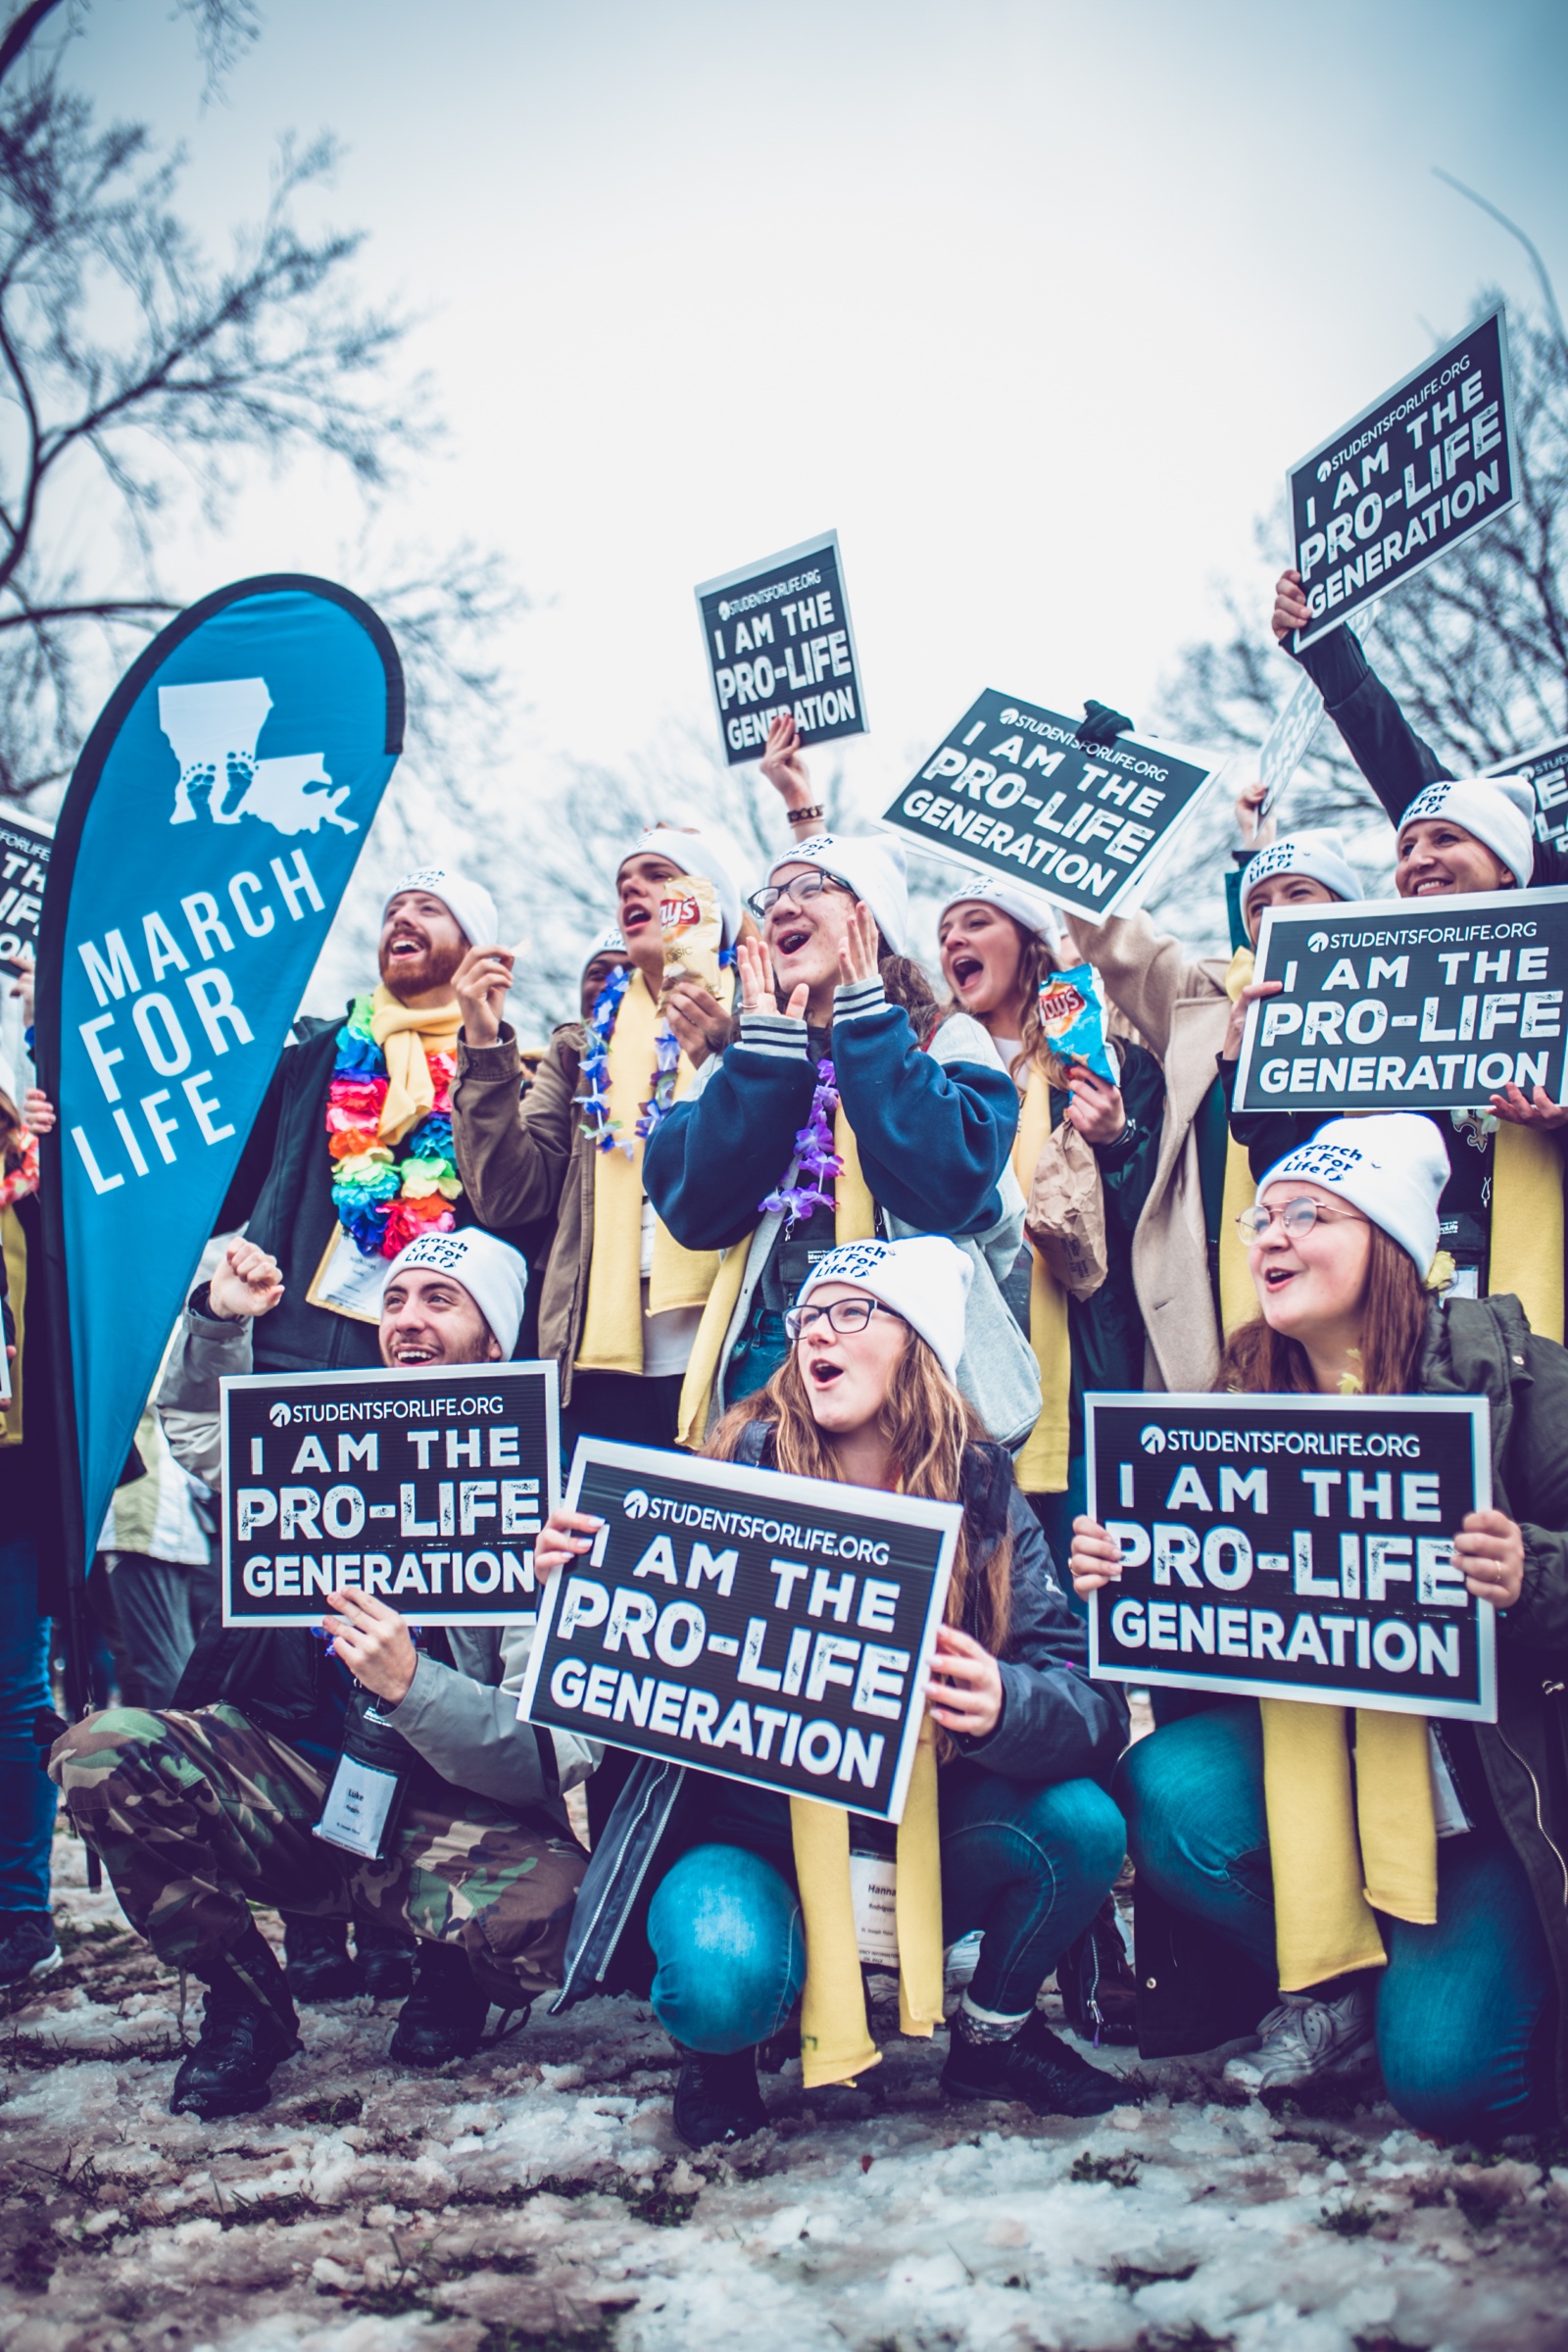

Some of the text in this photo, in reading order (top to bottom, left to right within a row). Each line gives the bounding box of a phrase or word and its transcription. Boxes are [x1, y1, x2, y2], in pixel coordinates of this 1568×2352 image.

[1331, 354, 1470, 470] STUDENTSFORLIFE.ORG
[1306, 369, 1484, 528] I AM THE
[1300, 400, 1502, 583] PRO-LIFE
[1306, 459, 1499, 619] GENERATION
[728, 569, 821, 615] STUDENTSFORLIFE.ORG
[714, 591, 835, 660] I AM THE
[715, 630, 852, 710] PRO-LIFE
[962, 720, 1166, 818] I AM THE
[1016, 714, 1168, 782] STUDENTSFORLIFE.ORG
[922, 747, 1155, 864] PRO-LIFE
[902, 790, 1117, 897] GENERATION
[1250, 864, 1273, 883] Life
[1267, 853, 1294, 864] For
[77, 848, 325, 1007] MARCH
[1330, 921, 1537, 949] STUDENTSFORLIFE.ORG
[1284, 947, 1549, 992] I AM THE
[78, 966, 256, 1103] FOR
[1260, 990, 1564, 1047] PRO-LIFE
[1259, 1052, 1549, 1094] GENERATION
[71, 1069, 236, 1195] LIFE
[1318, 1153, 1353, 1171] For
[1284, 1161, 1320, 1173] Life
[405, 1253, 436, 1262] Life
[433, 1246, 463, 1259] For
[815, 1264, 847, 1278] Life
[845, 1253, 877, 1267] For
[292, 1396, 504, 1423] STUDENTSFORLIFE.ORG
[251, 1426, 520, 1475] I AM THE
[1167, 1430, 1421, 1457] STUDENTSFORLIFE.ORG
[237, 1479, 541, 1541] PRO-LIFE
[1120, 1462, 1442, 1523] I AM THE
[648, 1497, 890, 1566] STUDENTSFORLIFE.ORG
[243, 1550, 535, 1597] GENERATION
[589, 1523, 901, 1633] I AM THE
[1104, 1520, 1468, 1607] PRO-LIFE
[557, 1577, 910, 1721] PRO-LIFE
[1111, 1598, 1459, 1678] GENERATION
[550, 1657, 885, 1788] GENERATION
[348, 1788, 364, 1802] Luke
